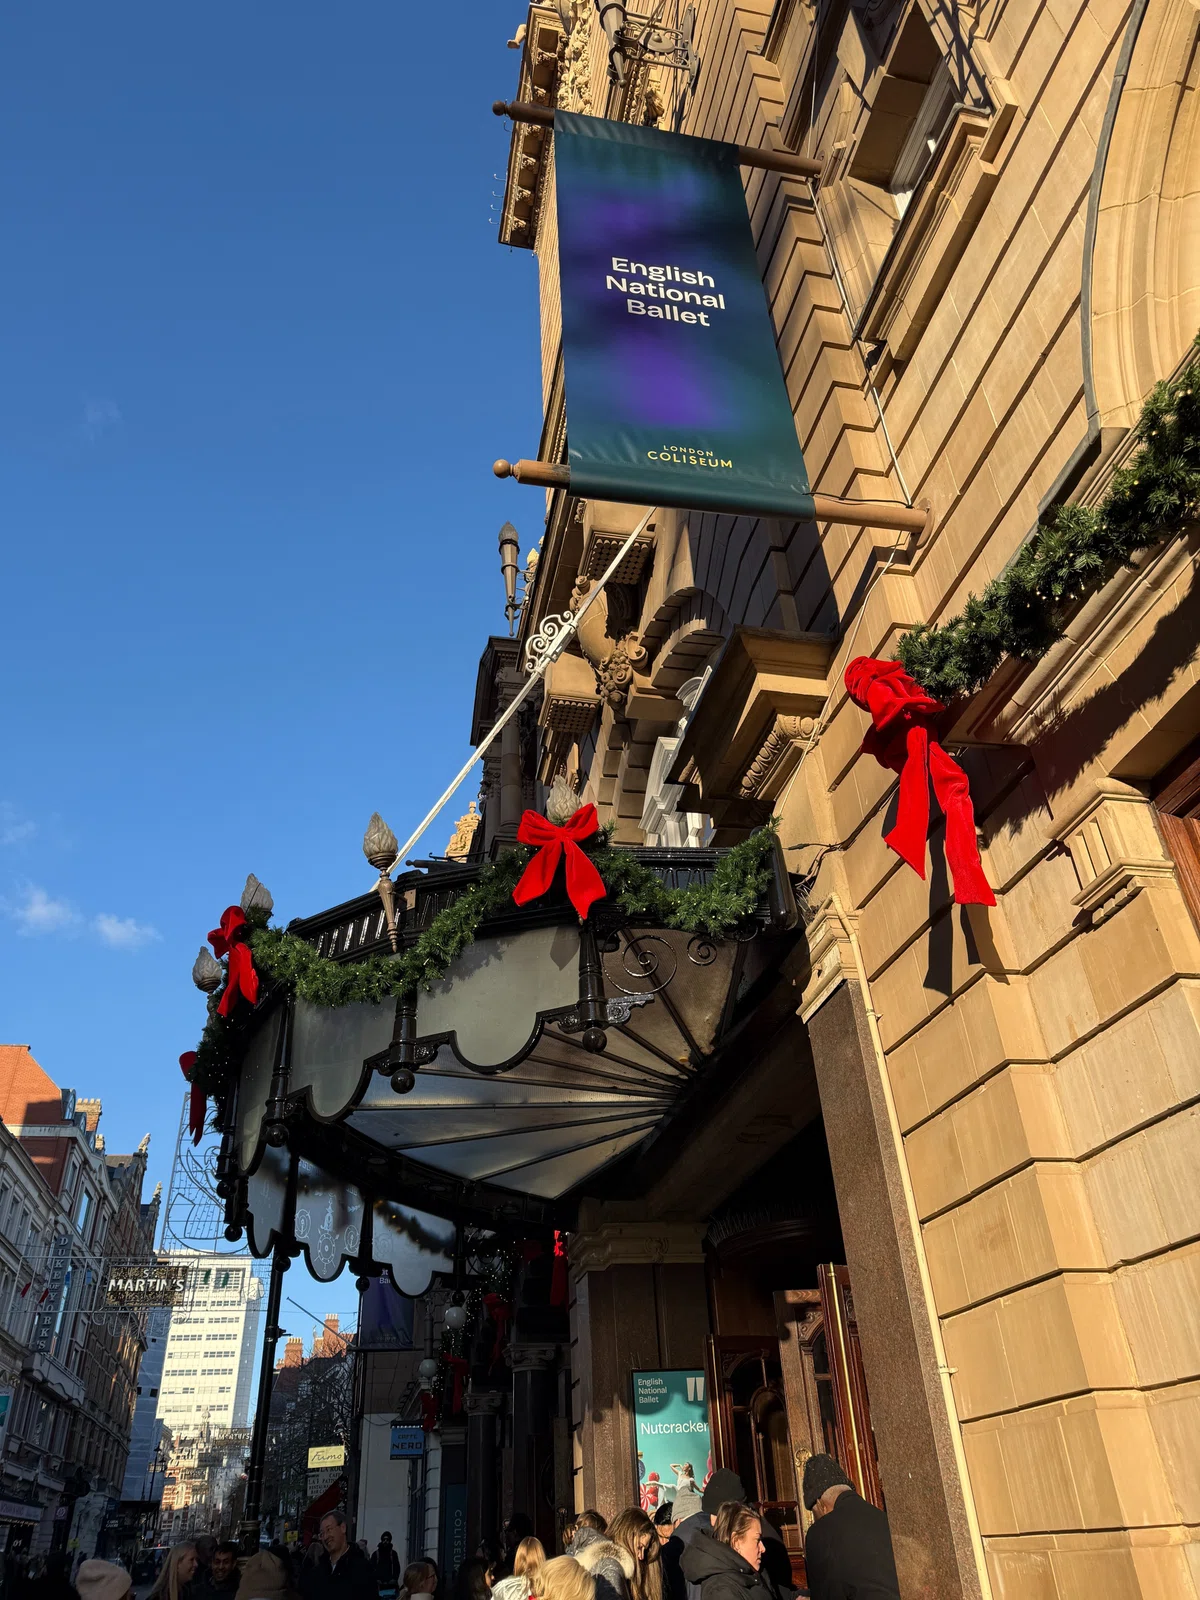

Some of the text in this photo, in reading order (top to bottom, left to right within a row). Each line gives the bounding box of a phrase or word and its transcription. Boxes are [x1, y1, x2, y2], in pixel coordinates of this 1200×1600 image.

[612, 257, 715, 288] English
[606, 275, 726, 310] National
[627, 299, 710, 327] Ballet
[663, 445, 714, 457] LONDON
[647, 451, 733, 468] COLISEUM
[52, 1236, 69, 1280] DUKE
[108, 1279, 185, 1291] MARTIN'S
[36, 1292, 58, 1349] YORK'S
[637, 1378, 664, 1387] English
[638, 1387, 668, 1395] National
[639, 1396, 660, 1404] Ballet
[641, 1420, 709, 1435] Nutcracker
[392, 1442, 422, 1450] NERO
[311, 1450, 343, 1462] Fumo
